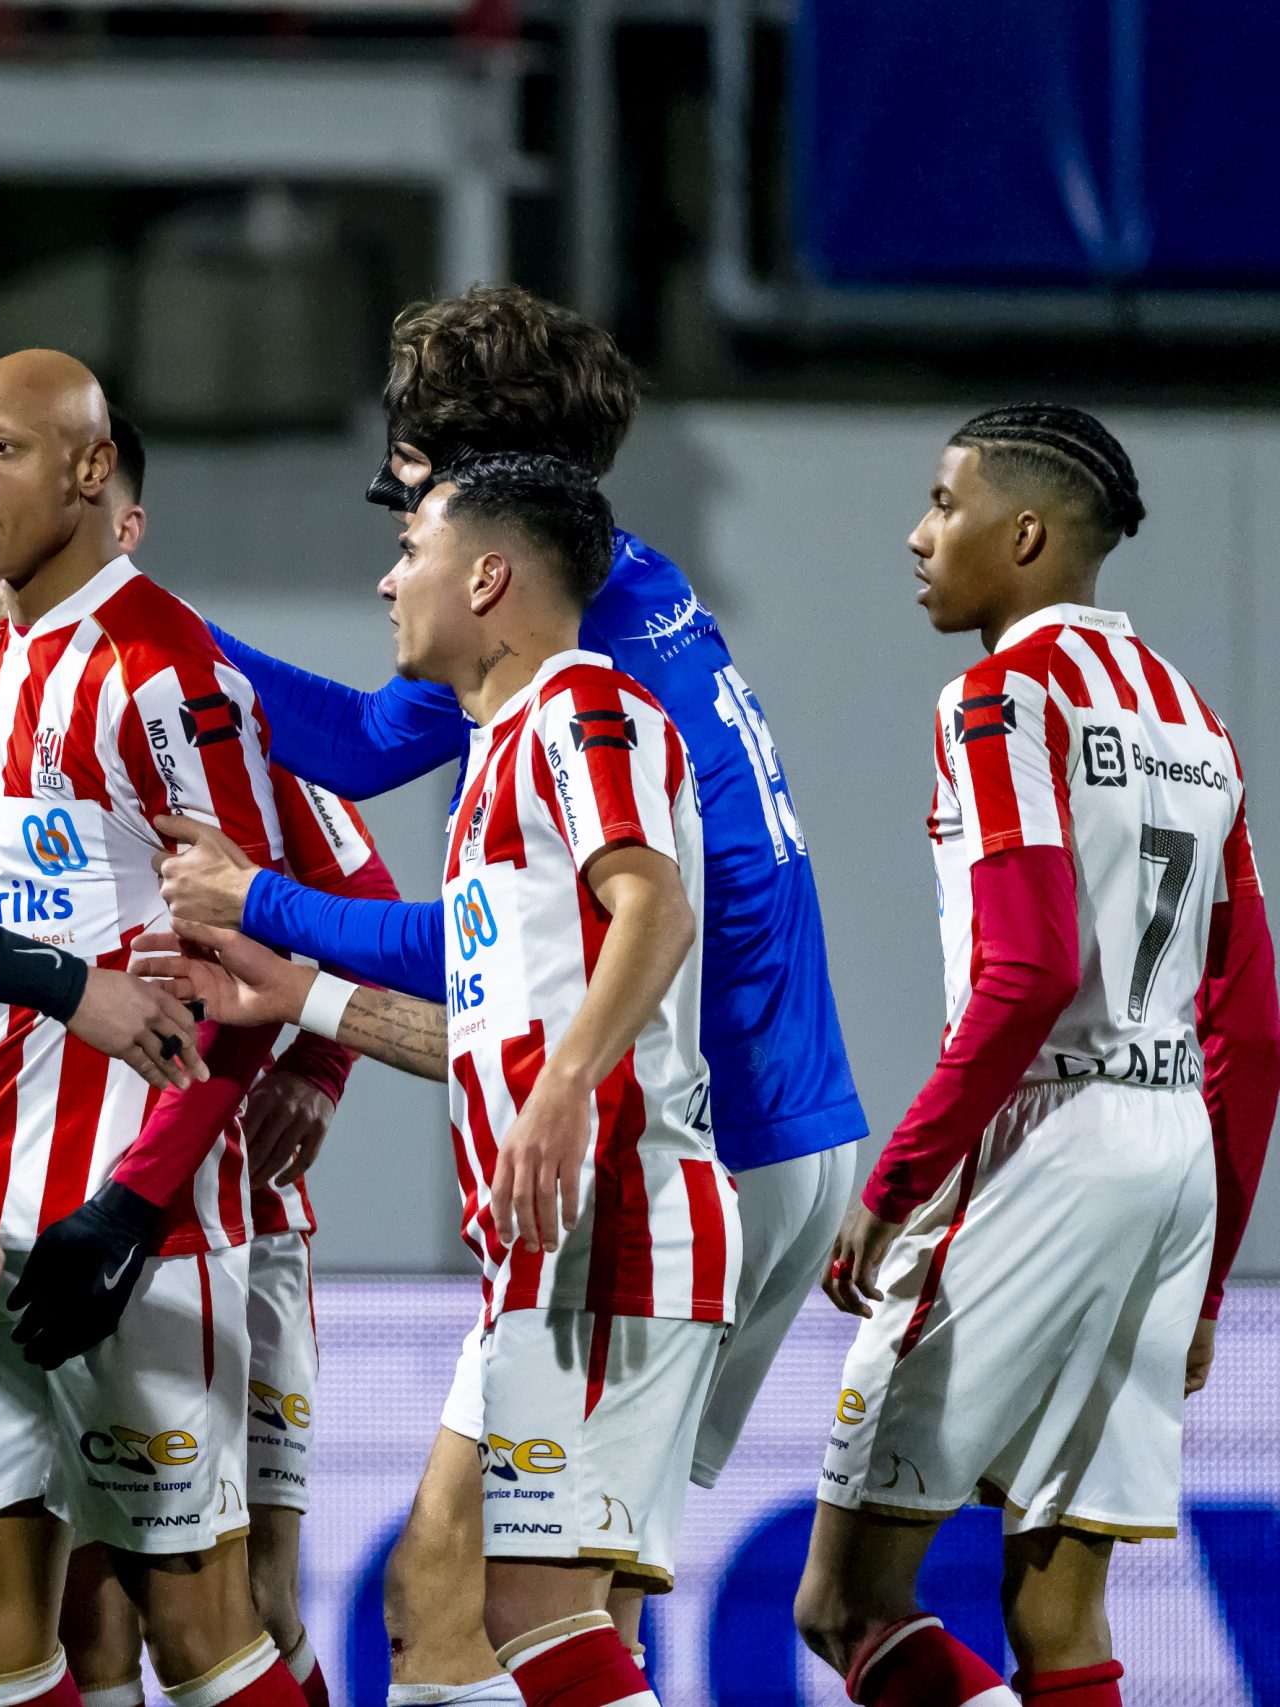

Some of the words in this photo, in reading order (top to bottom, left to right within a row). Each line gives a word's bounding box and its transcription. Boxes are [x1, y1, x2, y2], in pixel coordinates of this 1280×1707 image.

[147, 718, 168, 750] MD
[547, 741, 562, 770] MD
[555, 769, 580, 848] Stukadoors
[1127, 822, 1197, 1023] 7
[248, 1434, 282, 1446] ervice
[153, 1481, 192, 1493] Europe
[513, 1488, 555, 1501] Europe
[131, 1513, 201, 1527] STANNO
[493, 1523, 562, 1534] STANNO
